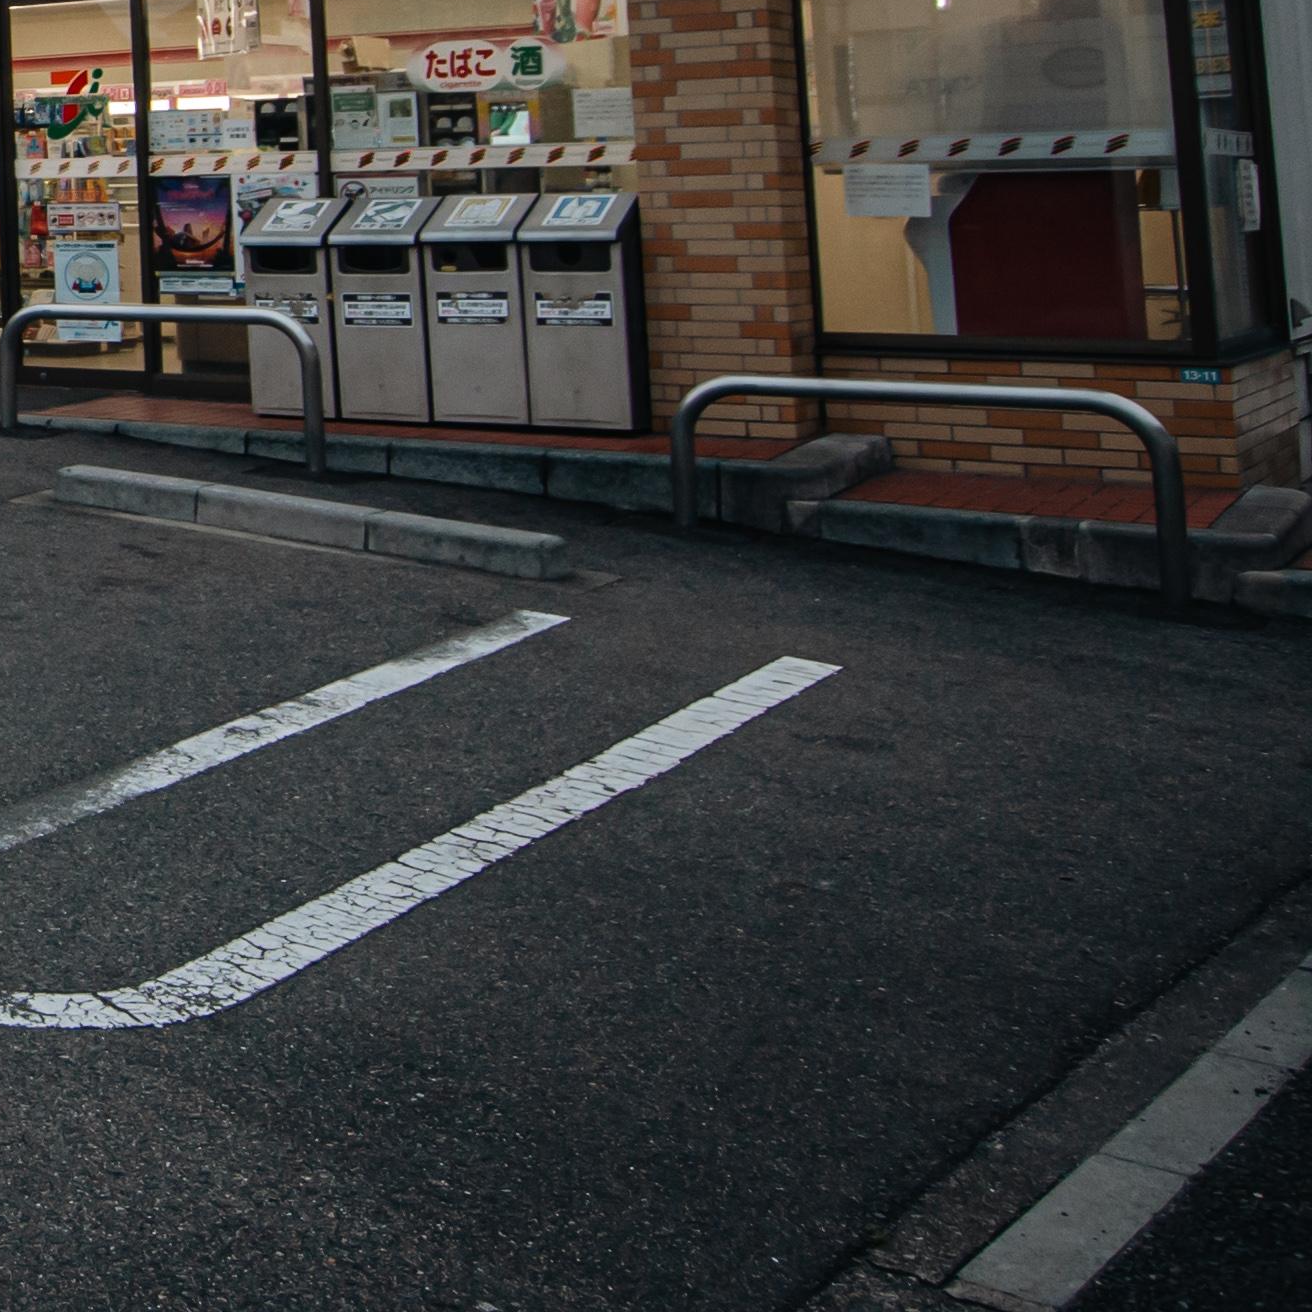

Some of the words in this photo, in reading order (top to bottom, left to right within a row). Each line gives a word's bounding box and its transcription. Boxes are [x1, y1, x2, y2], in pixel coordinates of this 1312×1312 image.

[425, 46, 497, 80] たばこ
[510, 45, 544, 76] 酒
